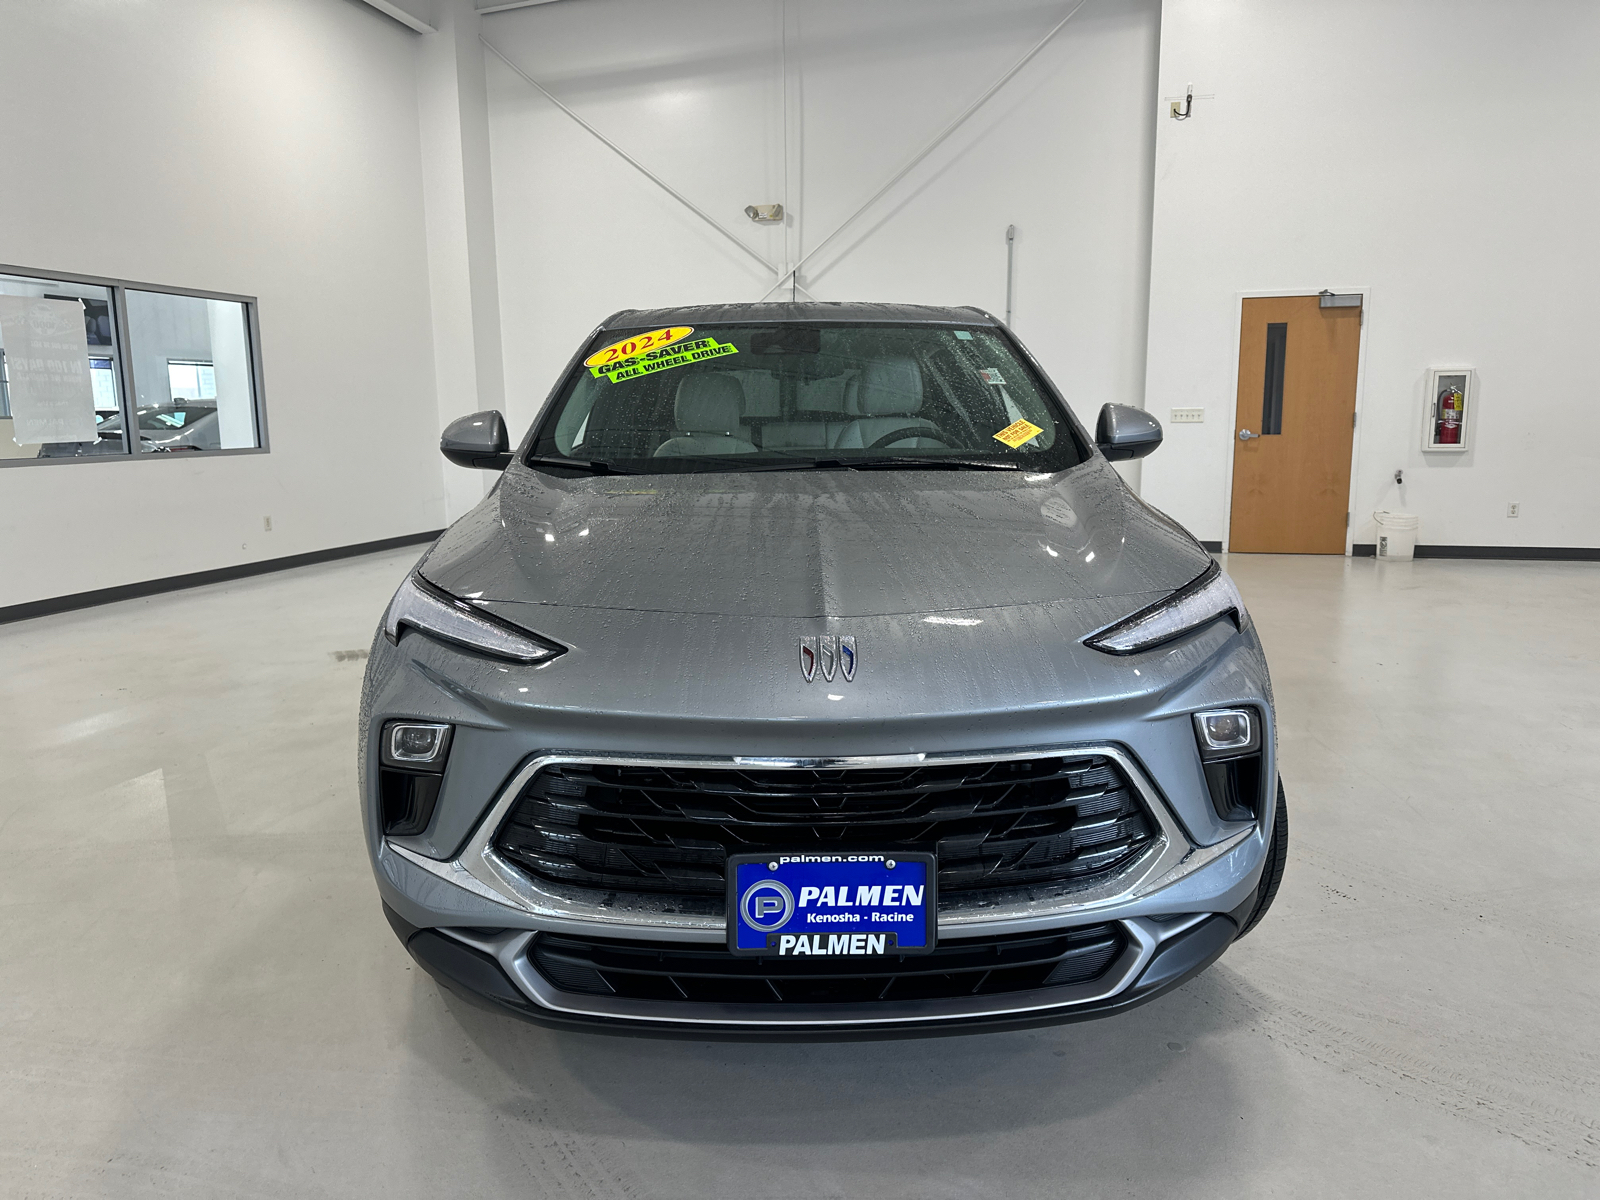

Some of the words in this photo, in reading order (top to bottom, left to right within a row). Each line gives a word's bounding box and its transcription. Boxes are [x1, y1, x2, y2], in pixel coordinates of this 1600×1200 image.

[603, 329, 673, 363] 2024
[597, 340, 710, 375] GAS-SAVER
[615, 367, 643, 380] ALL
[643, 355, 692, 372] WHEEL
[692, 345, 732, 360] DRIVE
[779, 855, 885, 865] palmen.com
[755, 896, 784, 918] P
[798, 885, 924, 907] PALMEN
[807, 912, 860, 923] Kenosha
[871, 912, 914, 922] Racine
[779, 934, 886, 955] PALMEN
